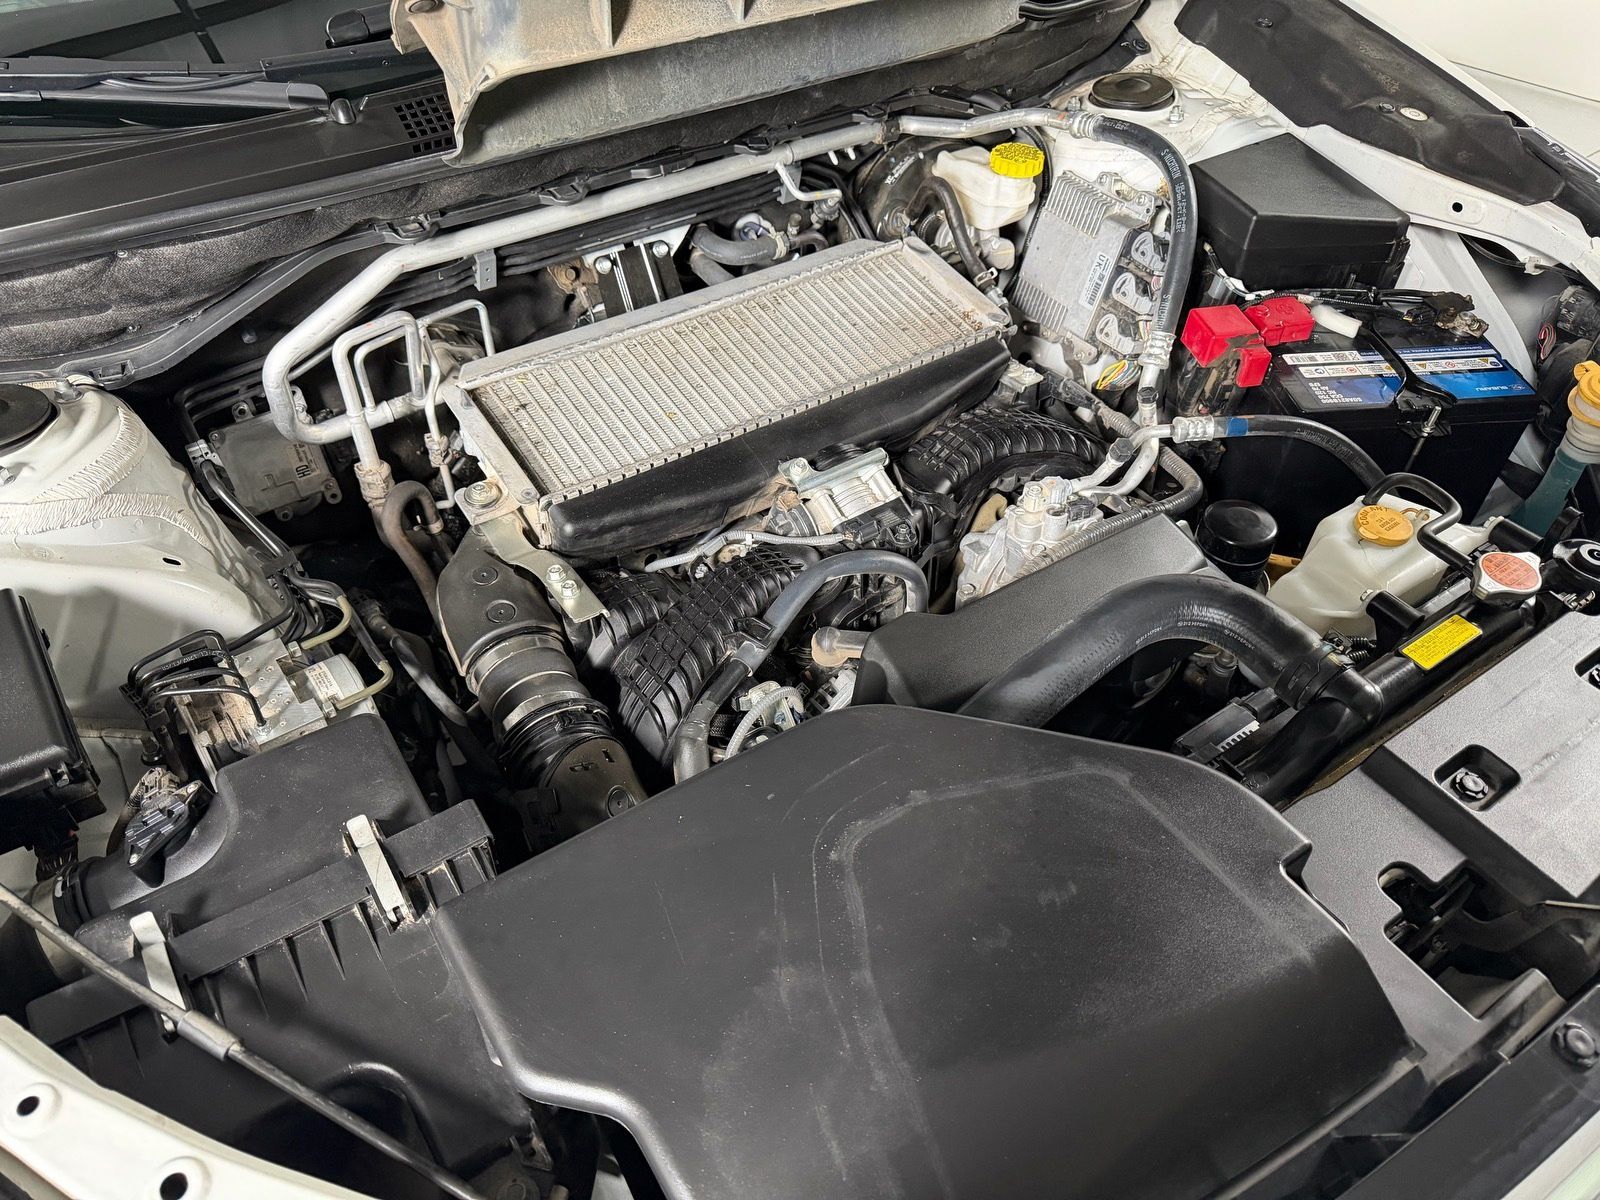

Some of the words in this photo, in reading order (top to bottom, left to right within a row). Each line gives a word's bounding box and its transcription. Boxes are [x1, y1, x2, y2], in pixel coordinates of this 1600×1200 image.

[1095, 254, 1106, 272] UK
[295, 464, 311, 479] HD
[1360, 506, 1391, 526] COOLANT
